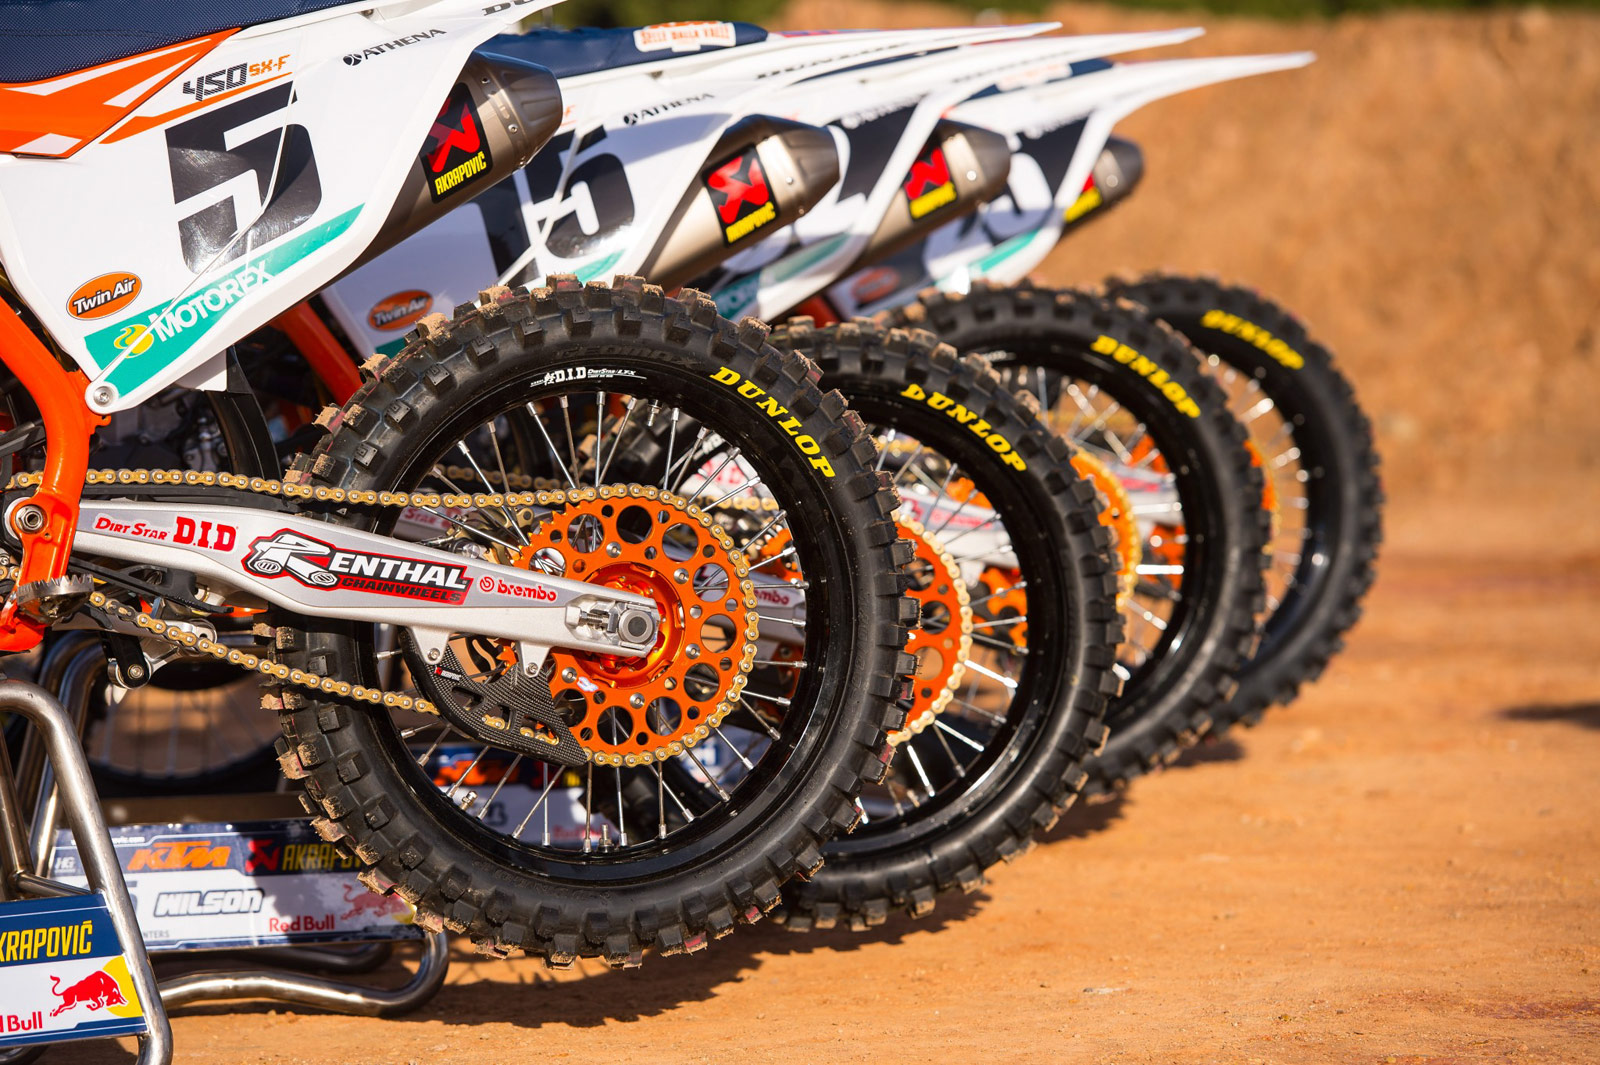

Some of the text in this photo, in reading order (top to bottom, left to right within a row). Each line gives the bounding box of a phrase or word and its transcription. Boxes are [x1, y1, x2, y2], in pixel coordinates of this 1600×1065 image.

[361, 28, 448, 60] ATHENA
[183, 54, 291, 102] 450 SX-F
[641, 92, 716, 118] ATHENA
[164, 80, 323, 275] 5
[73, 278, 136, 315] Twin Air
[148, 259, 276, 342] MOTOREX
[709, 366, 837, 478] DUNLOP
[901, 383, 1028, 472] DUNLOP
[173, 516, 237, 552] D.I.D
[247, 533, 468, 589] RENTHAL
[340, 576, 464, 602] CHAINWHEELS
[496, 578, 557, 603] brembo
[127, 841, 231, 871] KTM
[153, 887, 266, 919] WILSON
[269, 914, 335, 933] Red Bull
[7, 1011, 43, 1032] Bull
